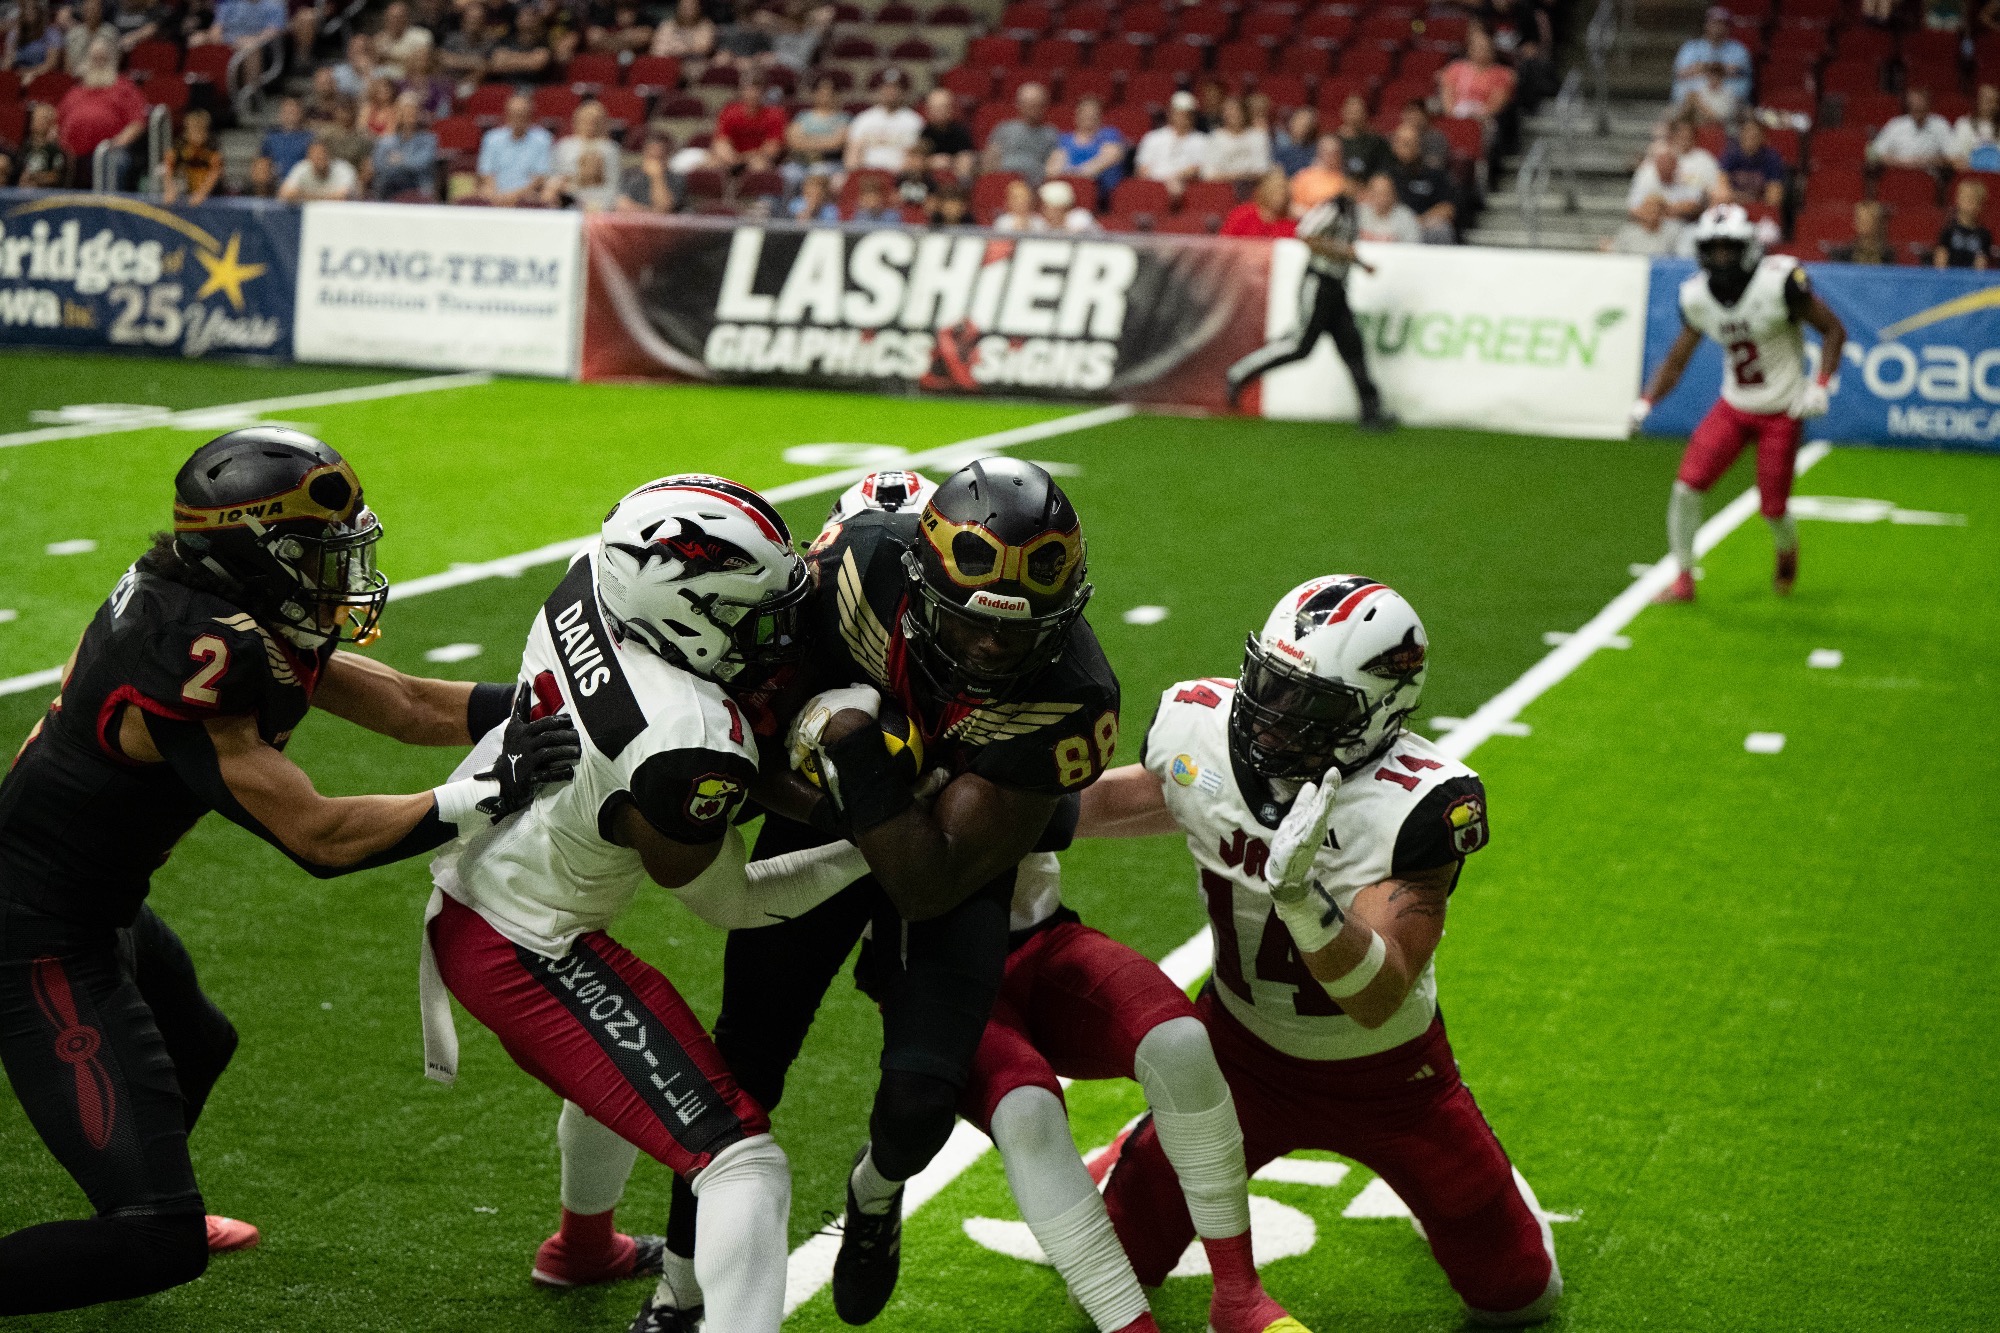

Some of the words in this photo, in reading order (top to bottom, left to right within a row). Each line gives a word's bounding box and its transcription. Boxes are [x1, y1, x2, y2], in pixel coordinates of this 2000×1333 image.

[0, 219, 161, 294] ridges
[318, 245, 561, 288] LONG-TERM
[107, 283, 184, 345] 25
[919, 318, 983, 391] &
[1728, 340, 1765, 388] 2
[218, 501, 284, 525] IOWA
[975, 594, 1026, 612] Riddell
[181, 632, 232, 708] 2
[554, 599, 611, 697] DAVIS
[1276, 638, 1305, 661] Riddell
[721, 698, 745, 748] 1
[1053, 709, 1120, 788] 88
[1374, 753, 1446, 793] 14
[1201, 867, 1346, 1017] 14
